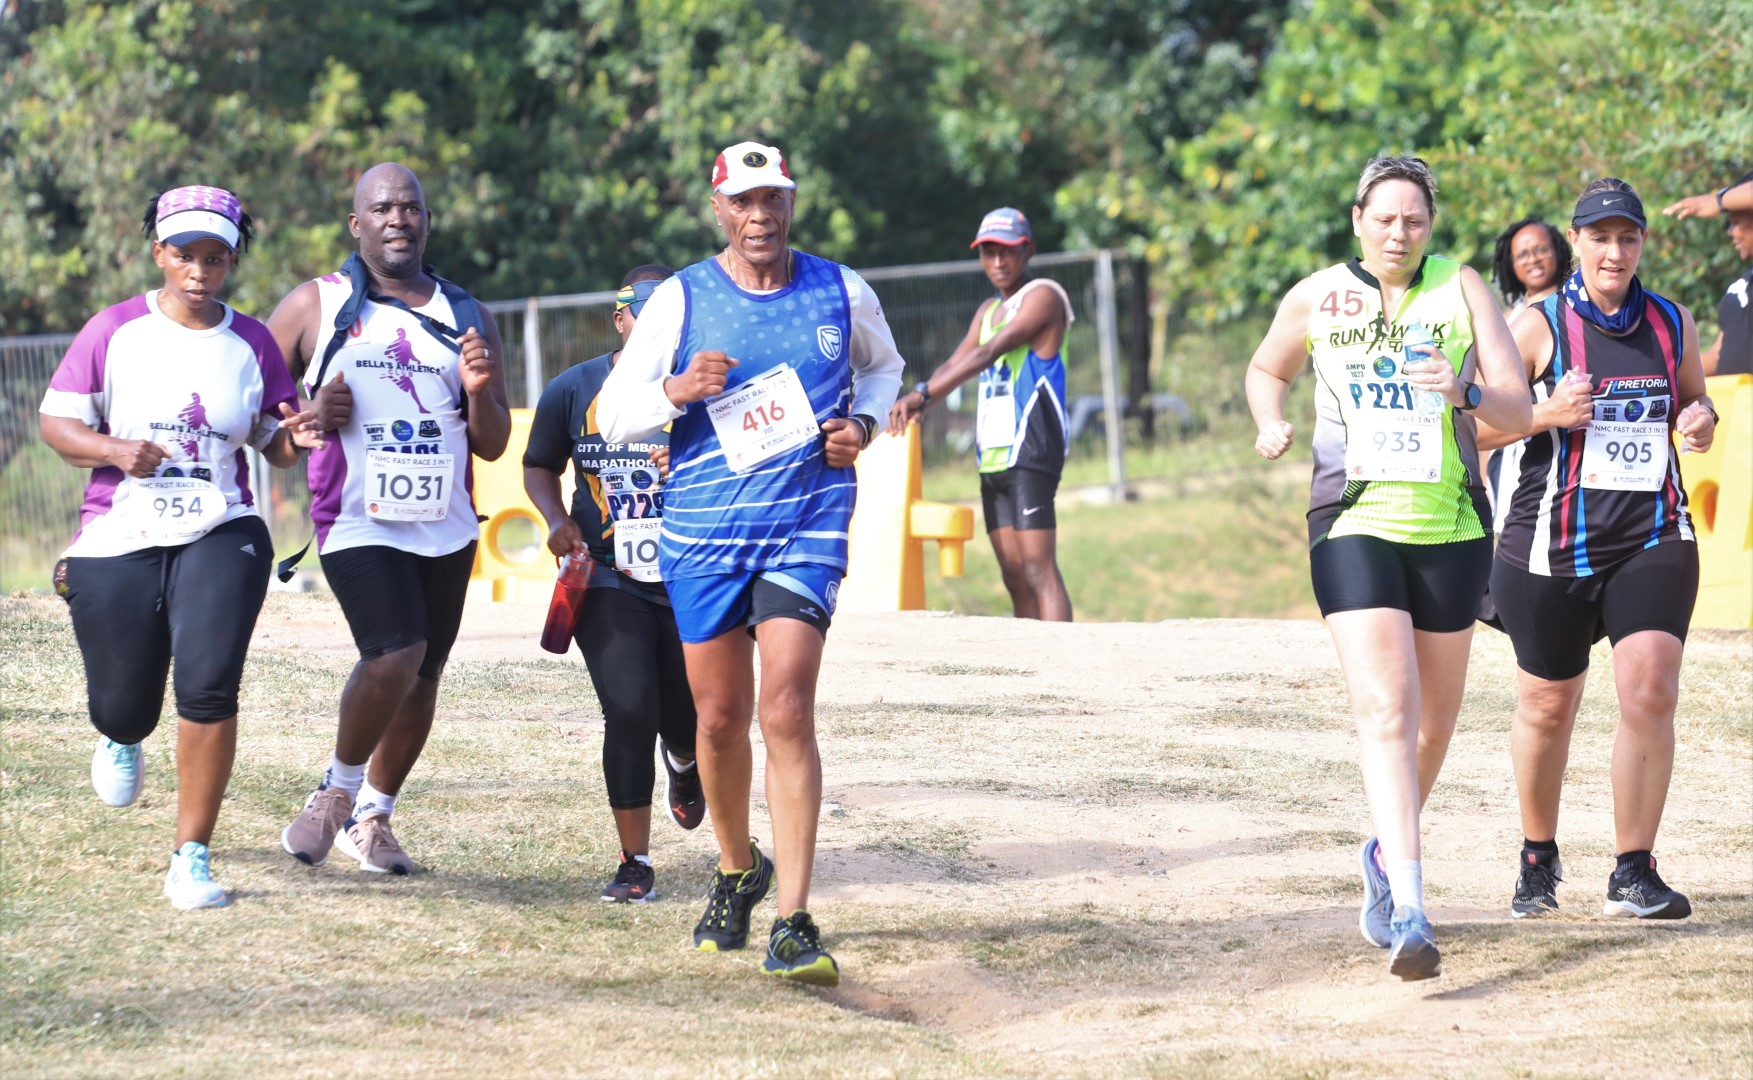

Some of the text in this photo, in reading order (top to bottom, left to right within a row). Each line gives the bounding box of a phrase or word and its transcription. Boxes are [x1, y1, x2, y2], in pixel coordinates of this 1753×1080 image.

[1319, 289, 1364, 317] 45
[1330, 323, 1446, 347] RUN WK
[356, 360, 441, 375] BELLA'S ATHLETICS
[388, 369, 414, 377] CLUB
[1617, 378, 1669, 390] PRETORIA
[715, 402, 733, 414] NMC
[732, 393, 750, 407] FAST
[743, 400, 785, 431] 416
[420, 421, 439, 431] ASA
[1594, 425, 1612, 433] NMC
[577, 443, 603, 453] CITY
[606, 443, 624, 452] OF
[1373, 431, 1421, 453] 935
[1606, 441, 1652, 463] 905
[393, 457, 412, 465] FAST
[413, 458, 431, 466] RACE
[582, 458, 655, 469] MARATHON
[377, 473, 443, 501] 1031
[153, 496, 203, 518] 954
[640, 522, 658, 530] FAST
